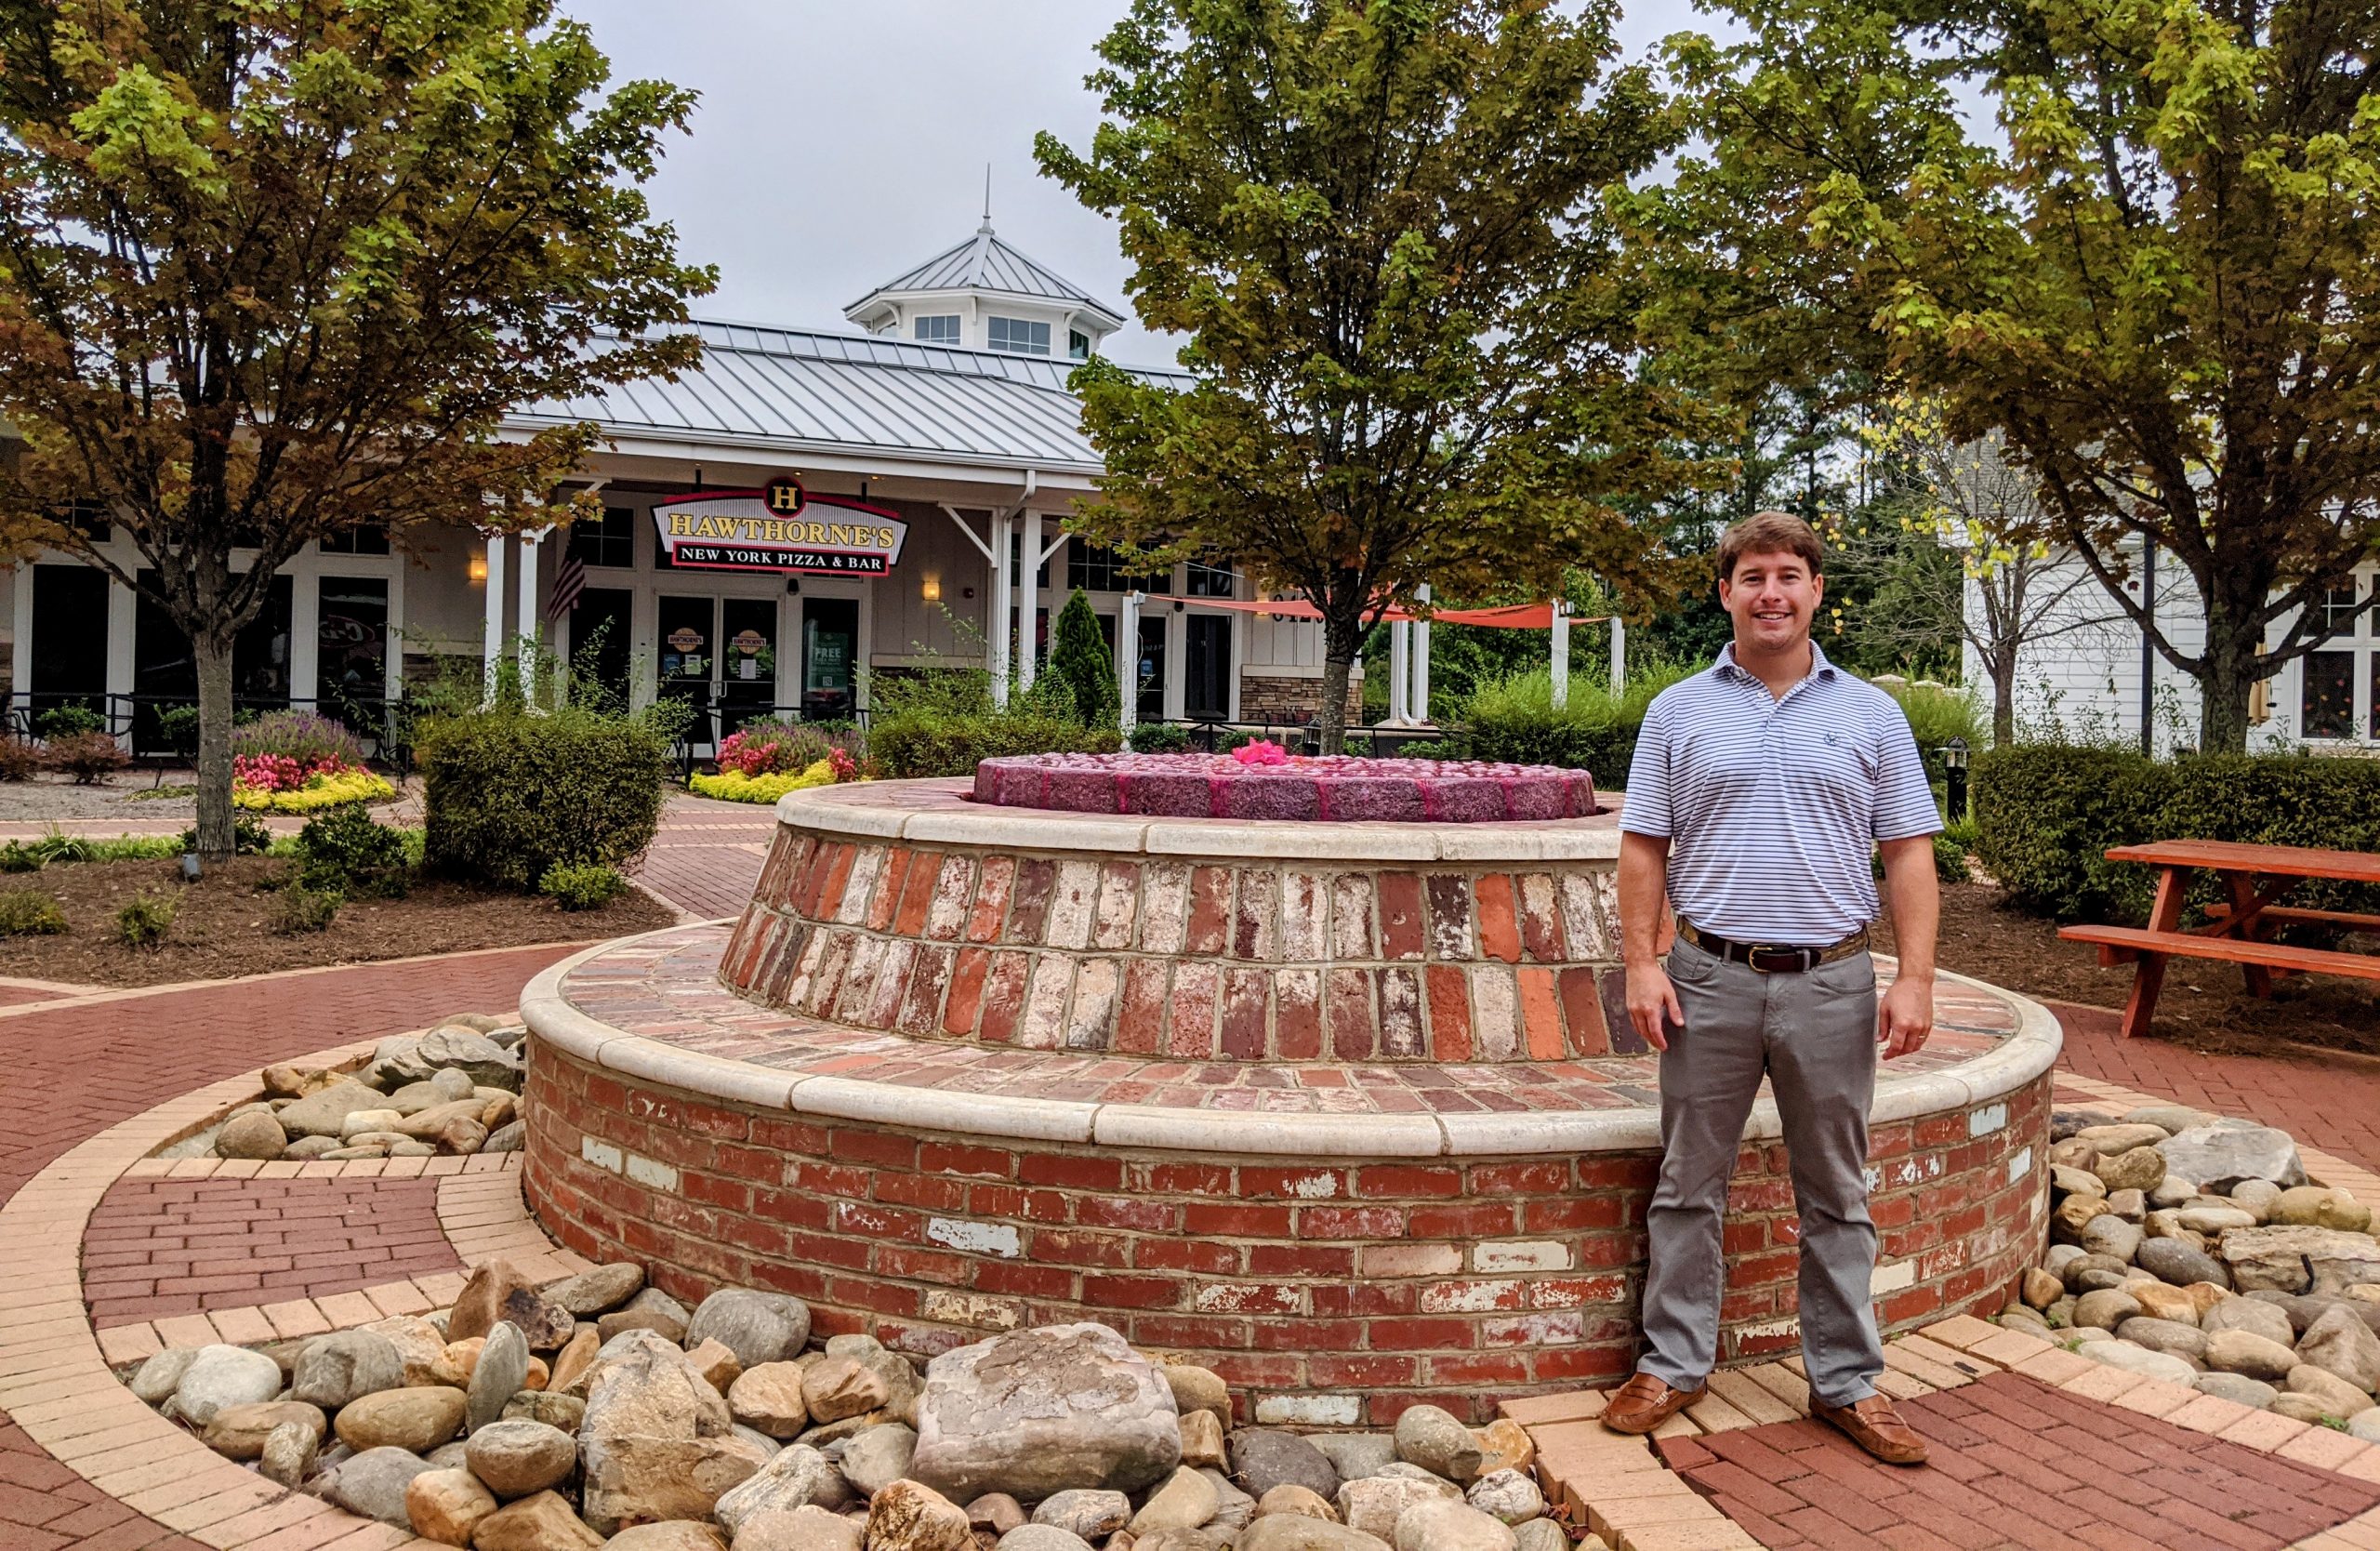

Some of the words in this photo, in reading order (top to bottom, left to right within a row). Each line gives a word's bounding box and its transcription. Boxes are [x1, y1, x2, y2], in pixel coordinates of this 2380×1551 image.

[773, 485, 799, 510] H
[668, 513, 895, 549] HAWTHORNE'S
[681, 548, 721, 561] NEW
[726, 550, 772, 564] YORK
[777, 553, 826, 567] PIZZA
[832, 556, 842, 568] &
[848, 557, 881, 570] BAR
[815, 647, 841, 659] FREE
